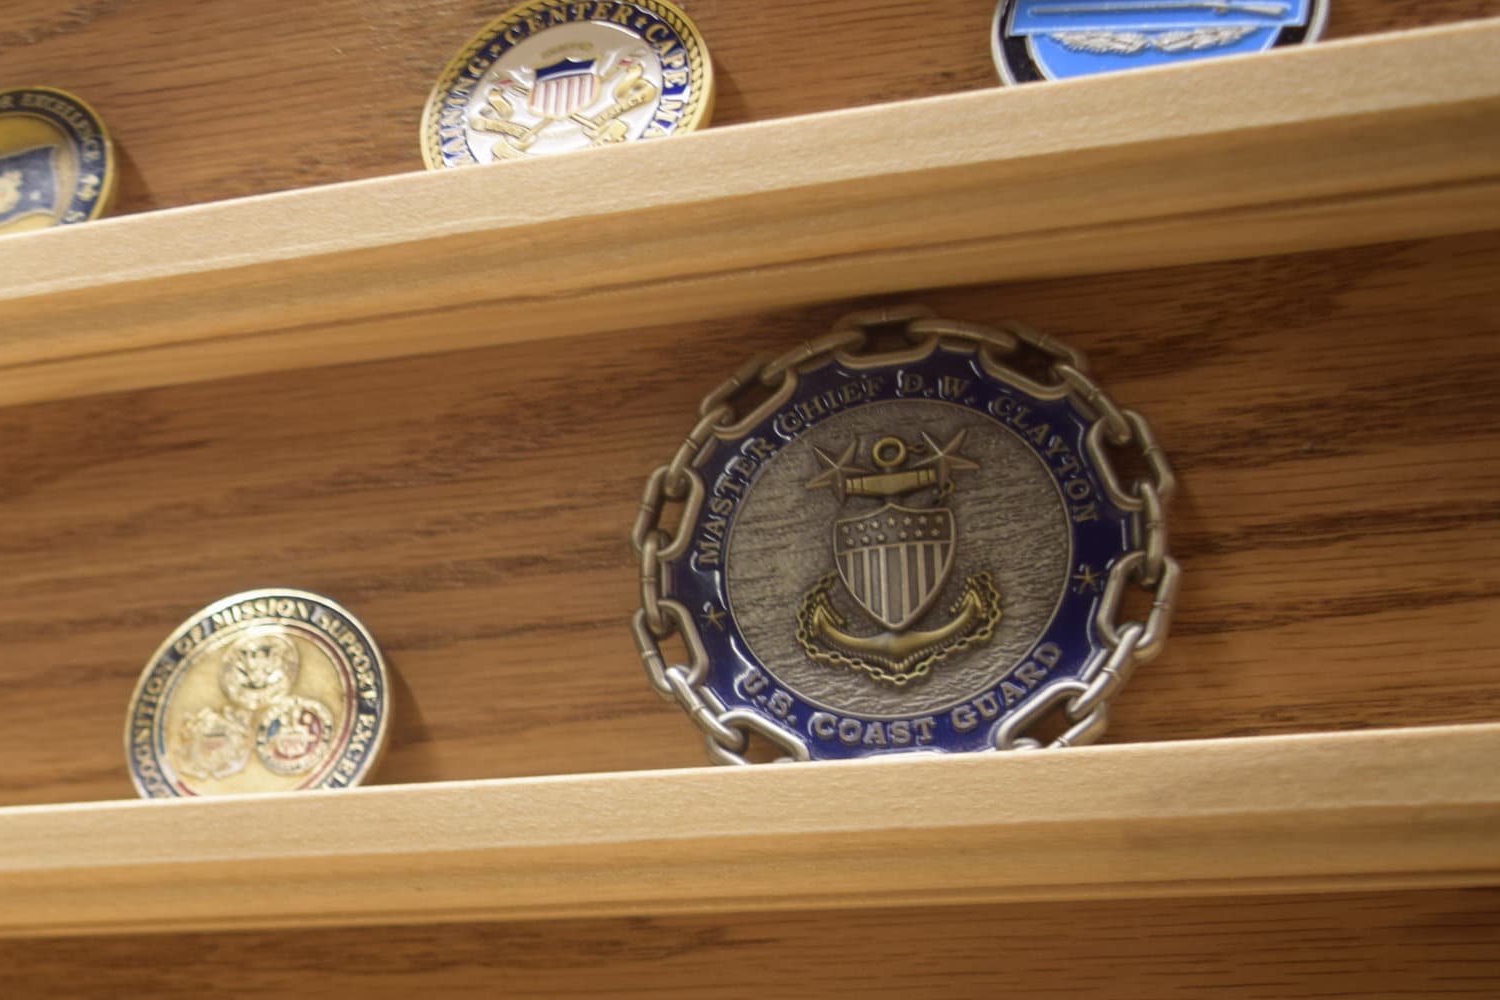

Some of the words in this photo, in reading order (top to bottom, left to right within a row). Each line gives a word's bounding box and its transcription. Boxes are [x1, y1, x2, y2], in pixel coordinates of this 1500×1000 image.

[503, 2, 631, 46] CENTER
[646, 23, 687, 88] CAPE
[698, 438, 774, 566] MASTER
[779, 375, 884, 433] CHIEF
[993, 397, 1098, 522] CLAYTON
[174, 622, 204, 654] OF
[211, 597, 310, 628] MISSION
[318, 613, 378, 701] SUPPORT
[741, 668, 797, 725] U.S.
[813, 713, 936, 745] COAST
[952, 642, 1063, 731] GUARD
